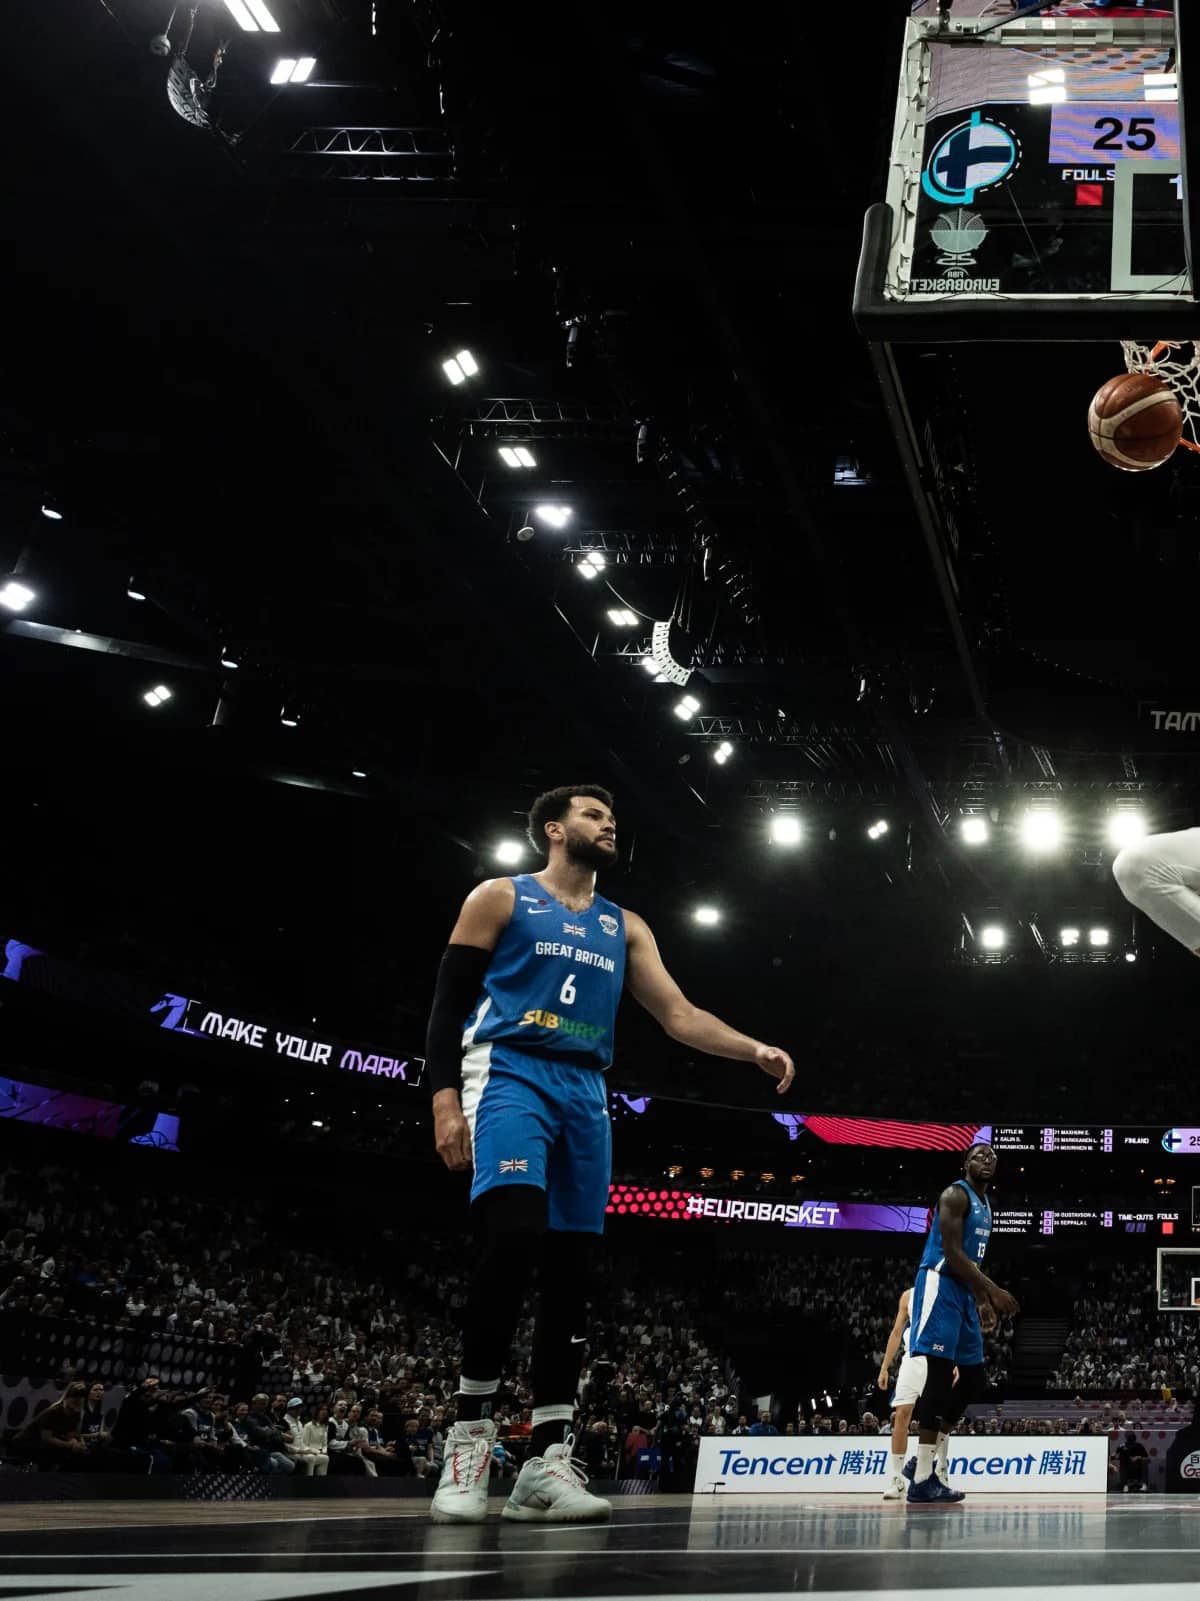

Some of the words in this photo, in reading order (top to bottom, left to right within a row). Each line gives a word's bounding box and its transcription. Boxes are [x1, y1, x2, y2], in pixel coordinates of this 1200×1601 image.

[1093, 117, 1156, 151] 25
[1062, 169, 1116, 181] FOULS
[535, 941, 573, 958] GREAT
[574, 948, 615, 973] BRITAIN
[560, 974, 577, 1005] 6
[200, 1011, 268, 1048] MAKE
[275, 1031, 332, 1066] YOUR
[339, 1049, 409, 1081] MARK
[687, 1195, 840, 1226] #EUROBASKET
[977, 1242, 986, 1259] 13
[719, 1449, 837, 1475] Tencent
[839, 1450, 888, 1475] 腾讯
[945, 1453, 1037, 1475] ncent
[1039, 1450, 1086, 1475] 腾讯
